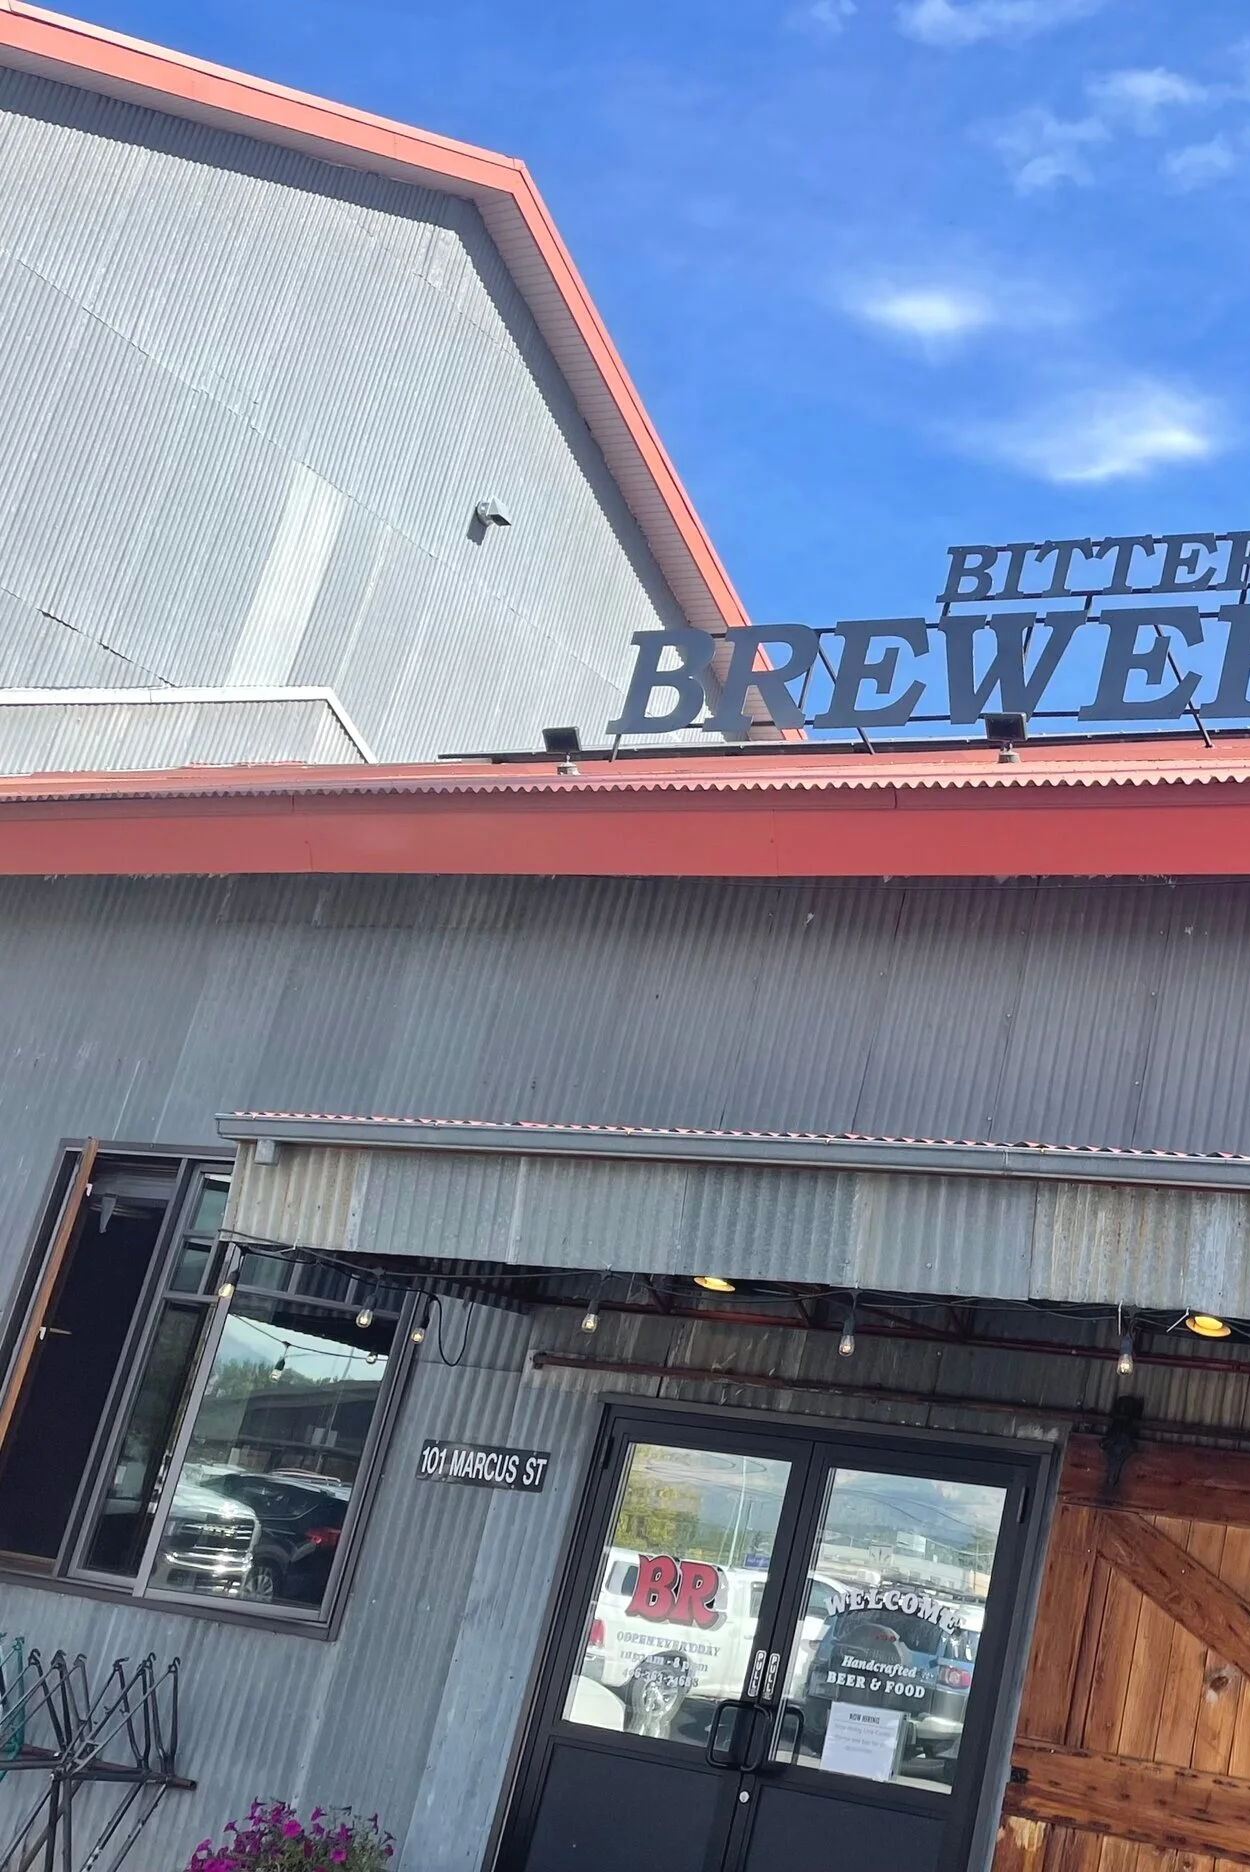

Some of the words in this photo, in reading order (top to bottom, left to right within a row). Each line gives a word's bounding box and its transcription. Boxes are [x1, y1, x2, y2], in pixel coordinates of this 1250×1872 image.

[421, 1446, 447, 1474] 101
[449, 1449, 519, 1483] MARCUS
[522, 1457, 547, 1486] ST
[625, 1554, 727, 1631] BR
[824, 1589, 962, 1635] WELCOME
[752, 1652, 764, 1689] PULL
[766, 1655, 777, 1692] PULL
[826, 1671, 865, 1689] BEER
[870, 1677, 881, 1691] &
[884, 1681, 926, 1698] FOOD
[841, 1655, 917, 1678] Handcrafted
